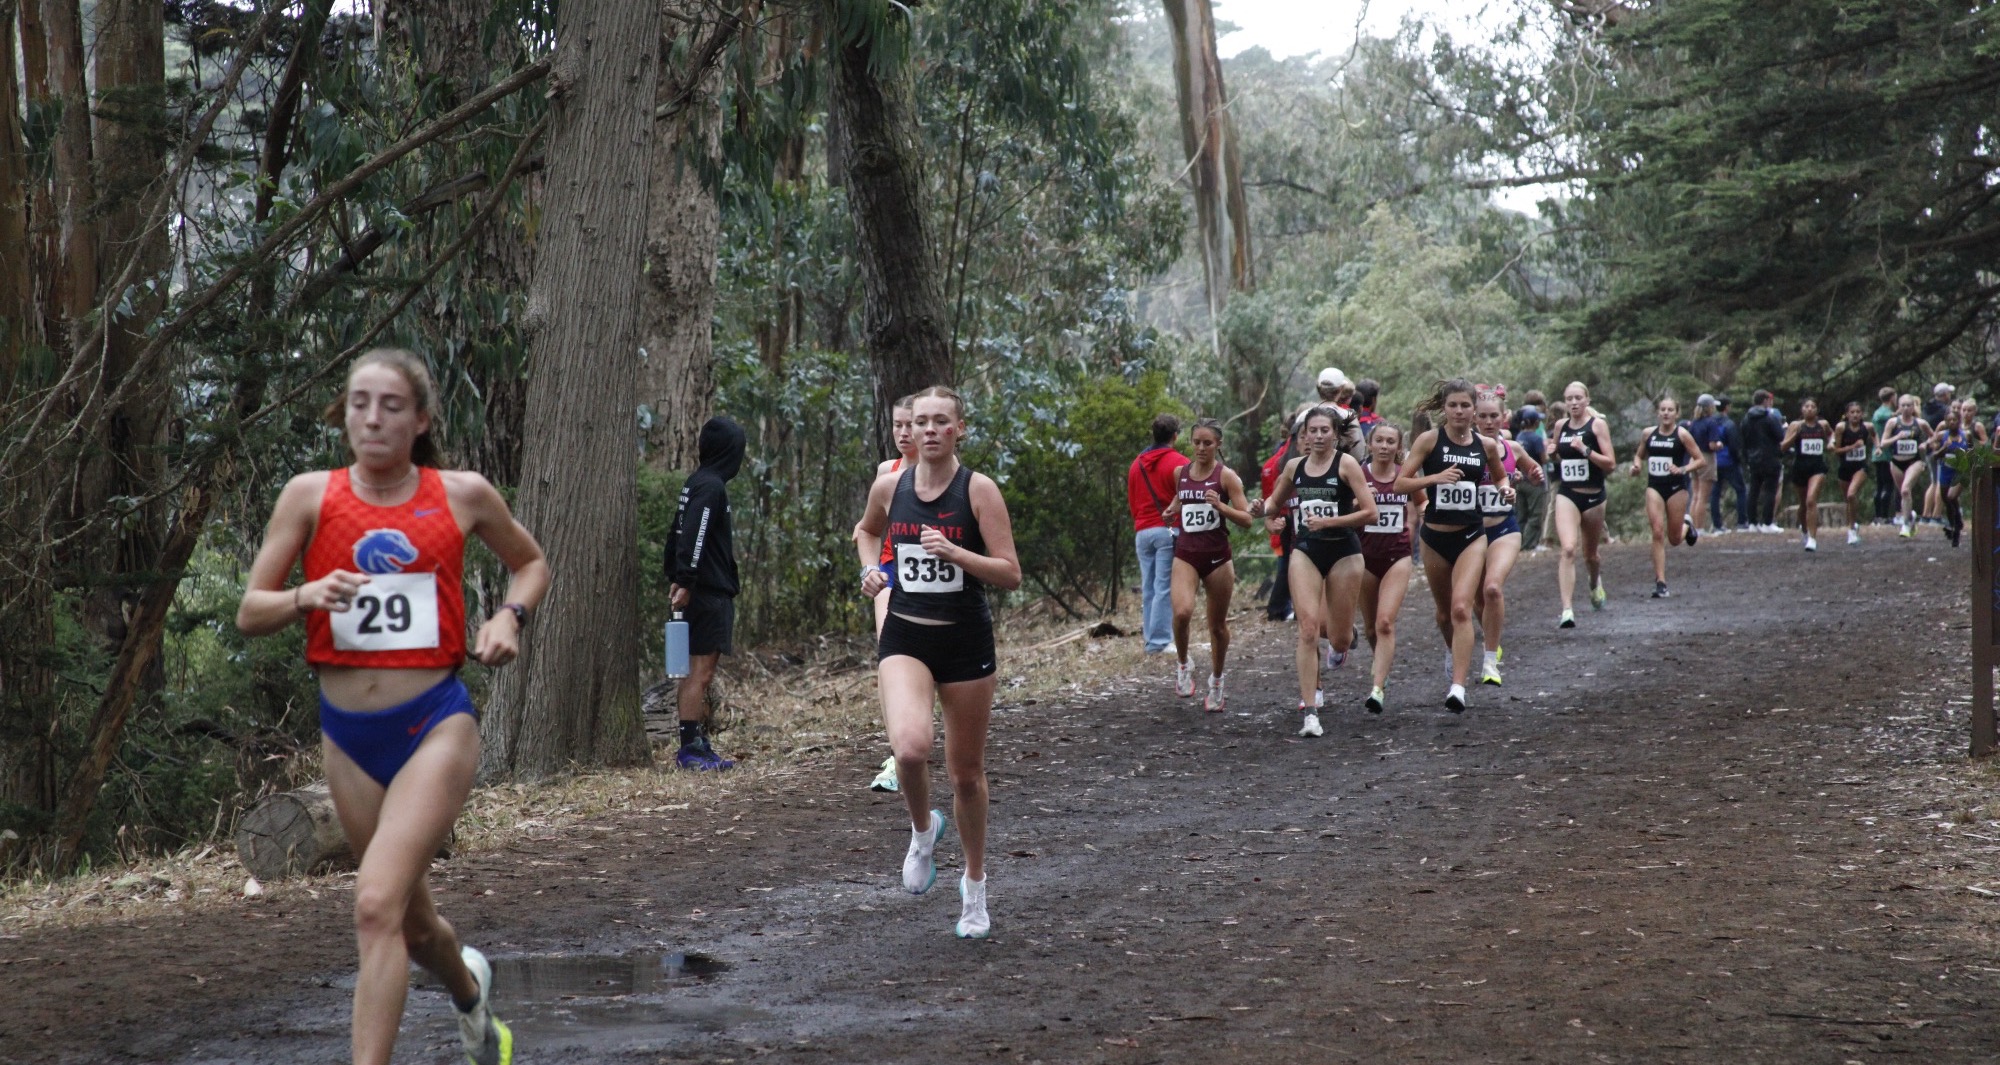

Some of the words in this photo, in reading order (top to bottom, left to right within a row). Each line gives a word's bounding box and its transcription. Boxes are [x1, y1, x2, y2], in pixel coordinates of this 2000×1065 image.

[1804, 442, 1821, 452] 340
[1900, 443, 1915, 452] 207
[1443, 454, 1480, 466] STANFORD
[1651, 461, 1670, 472] 310
[1564, 464, 1586, 477] 315
[1440, 488, 1473, 504] 309
[1185, 510, 1216, 527] 254
[1378, 511, 1400, 527] 57
[891, 522, 920, 536] STAN
[928, 525, 963, 539] ATE
[904, 556, 956, 583] 335
[356, 593, 412, 635] 29
